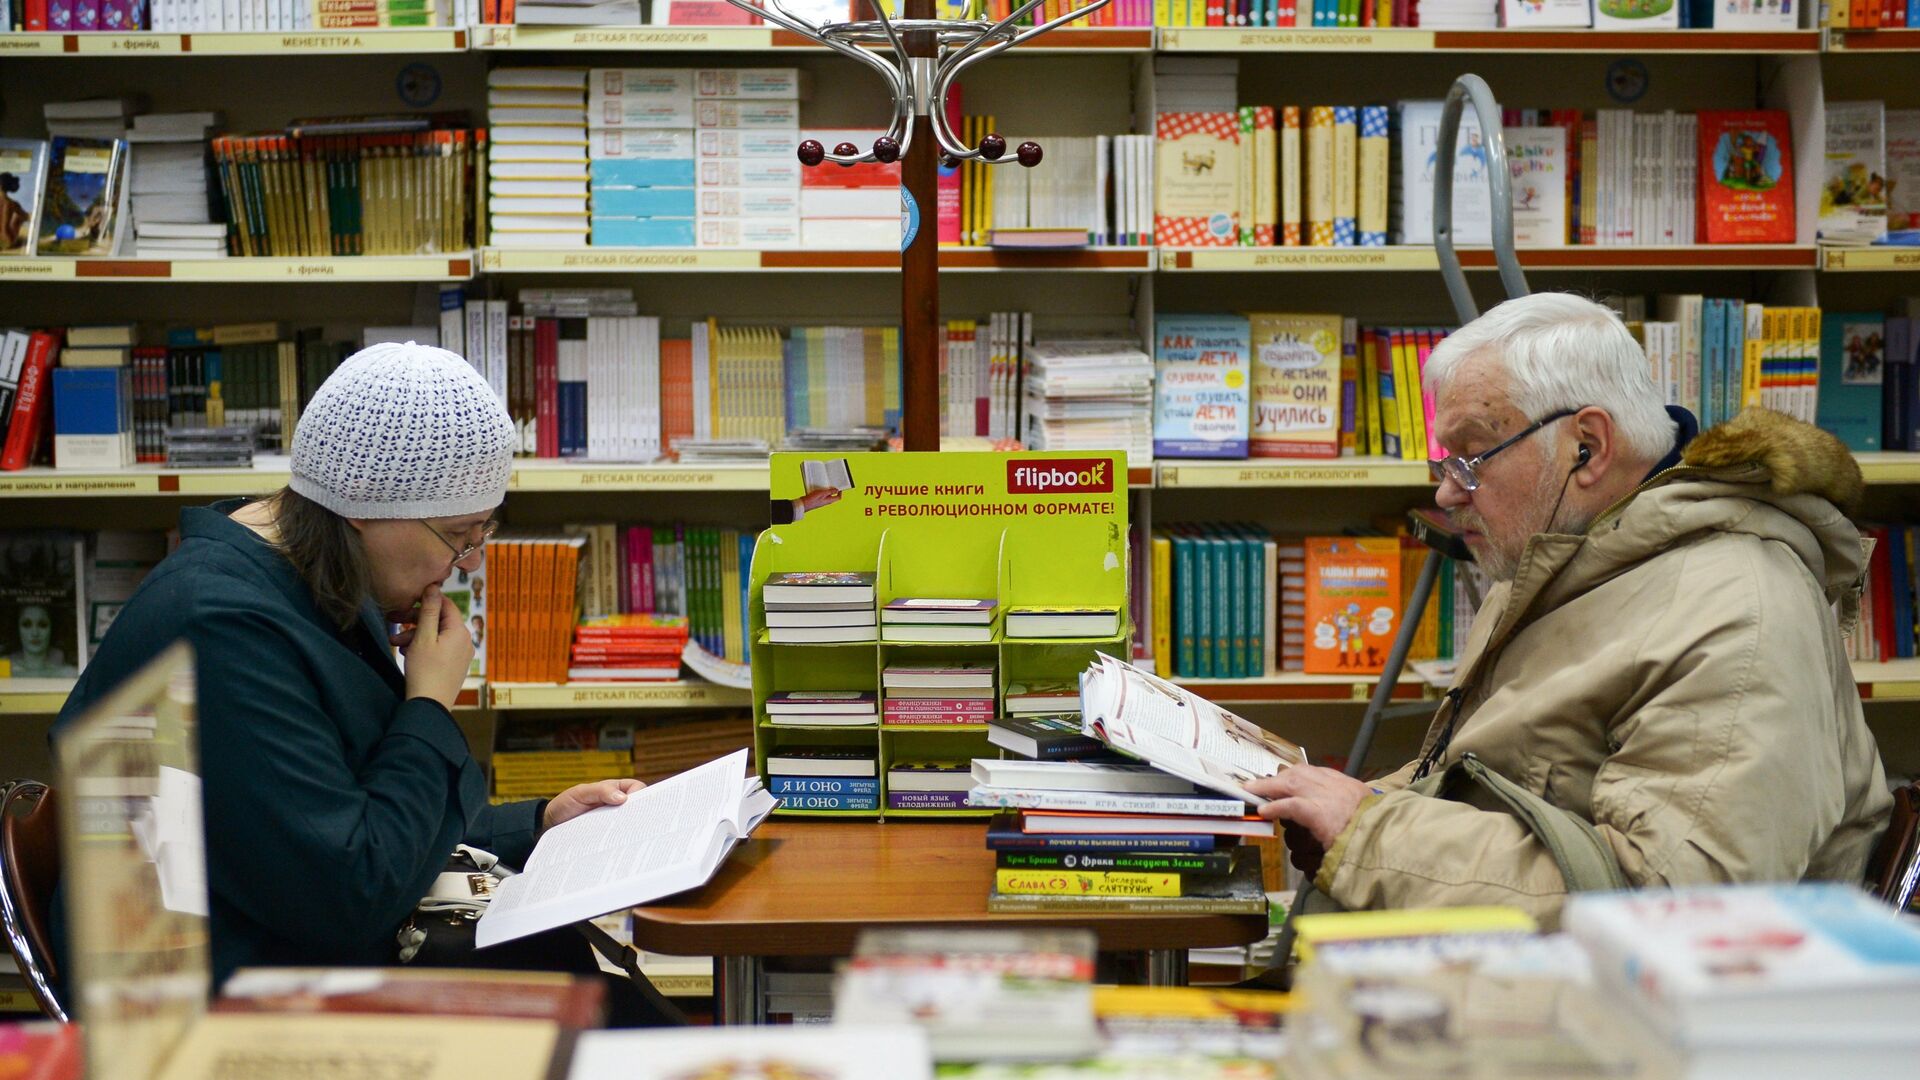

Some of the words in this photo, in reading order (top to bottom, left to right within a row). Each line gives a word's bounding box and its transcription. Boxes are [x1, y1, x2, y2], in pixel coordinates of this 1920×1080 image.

[282, 37, 349, 48] МЕНЕГЕТТИ
[573, 33, 627, 43] ДЕТСКАЯ
[629, 33, 708, 43] ПСИХОЛОГИЯ
[1240, 35, 1293, 45] ДЕТСКАЯ
[1295, 35, 1373, 45] ПСИХОЛОГИЯ
[123, 40, 160, 50] фрейд
[563, 255, 618, 265] ДЕТСКАЯ
[620, 255, 698, 265] ПСИХОЛОГИЯ
[1254, 255, 1306, 265] ДЕТСКАЯ
[1309, 255, 1385, 265] ПСИХОЛОГИЯ
[298, 265, 334, 275] фрейд
[1163, 335, 1193, 349] КАК
[1199, 350, 1238, 365] ДЕТИ
[1293, 385, 1327, 401] ОНИ
[1196, 404, 1236, 419] ДЕТИ
[581, 474, 633, 484] ДЕТСКАЯ
[636, 474, 713, 484] ПСИХОЛОГИЯ
[1015, 465, 1105, 489] flipbook
[1239, 470, 1290, 481] ДЕТСКАЯ
[1294, 470, 1369, 480] ПСИХОЛОГИЯ
[16, 482, 52, 490] школы
[65, 481, 136, 492] направления
[864, 484, 928, 499] лучшие
[934, 484, 984, 496] книги
[864, 505, 873, 516] в
[878, 503, 1028, 518] РЕВОЛЮЦИОННОМ
[1033, 502, 1115, 516] ФОРМАТЕ!
[573, 690, 625, 701] ДЕТСКАЯ
[628, 689, 706, 700] ПСИХОЛОГИЯ
[781, 781, 791, 793] Я
[796, 781, 806, 792] И
[810, 781, 842, 792] ОНО
[778, 797, 788, 808] Я
[793, 797, 803, 807] И
[807, 797, 839, 808] ОНО
[1095, 800, 1117, 808] ИГРА
[1122, 800, 1160, 809] СТИХИЙ:
[1167, 802, 1189, 810] ВОДА
[1194, 803, 1200, 811] И
[1204, 804, 1238, 812] ВОЗДУХ
[1050, 839, 1076, 847] ПОЧЕМУ
[1078, 839, 1090, 847] МЫ
[1091, 839, 1127, 847] ВЫЖИВЕМ
[1116, 858, 1169, 868] наследуют
[1099, 884, 1153, 894] САНТЕХНИК
